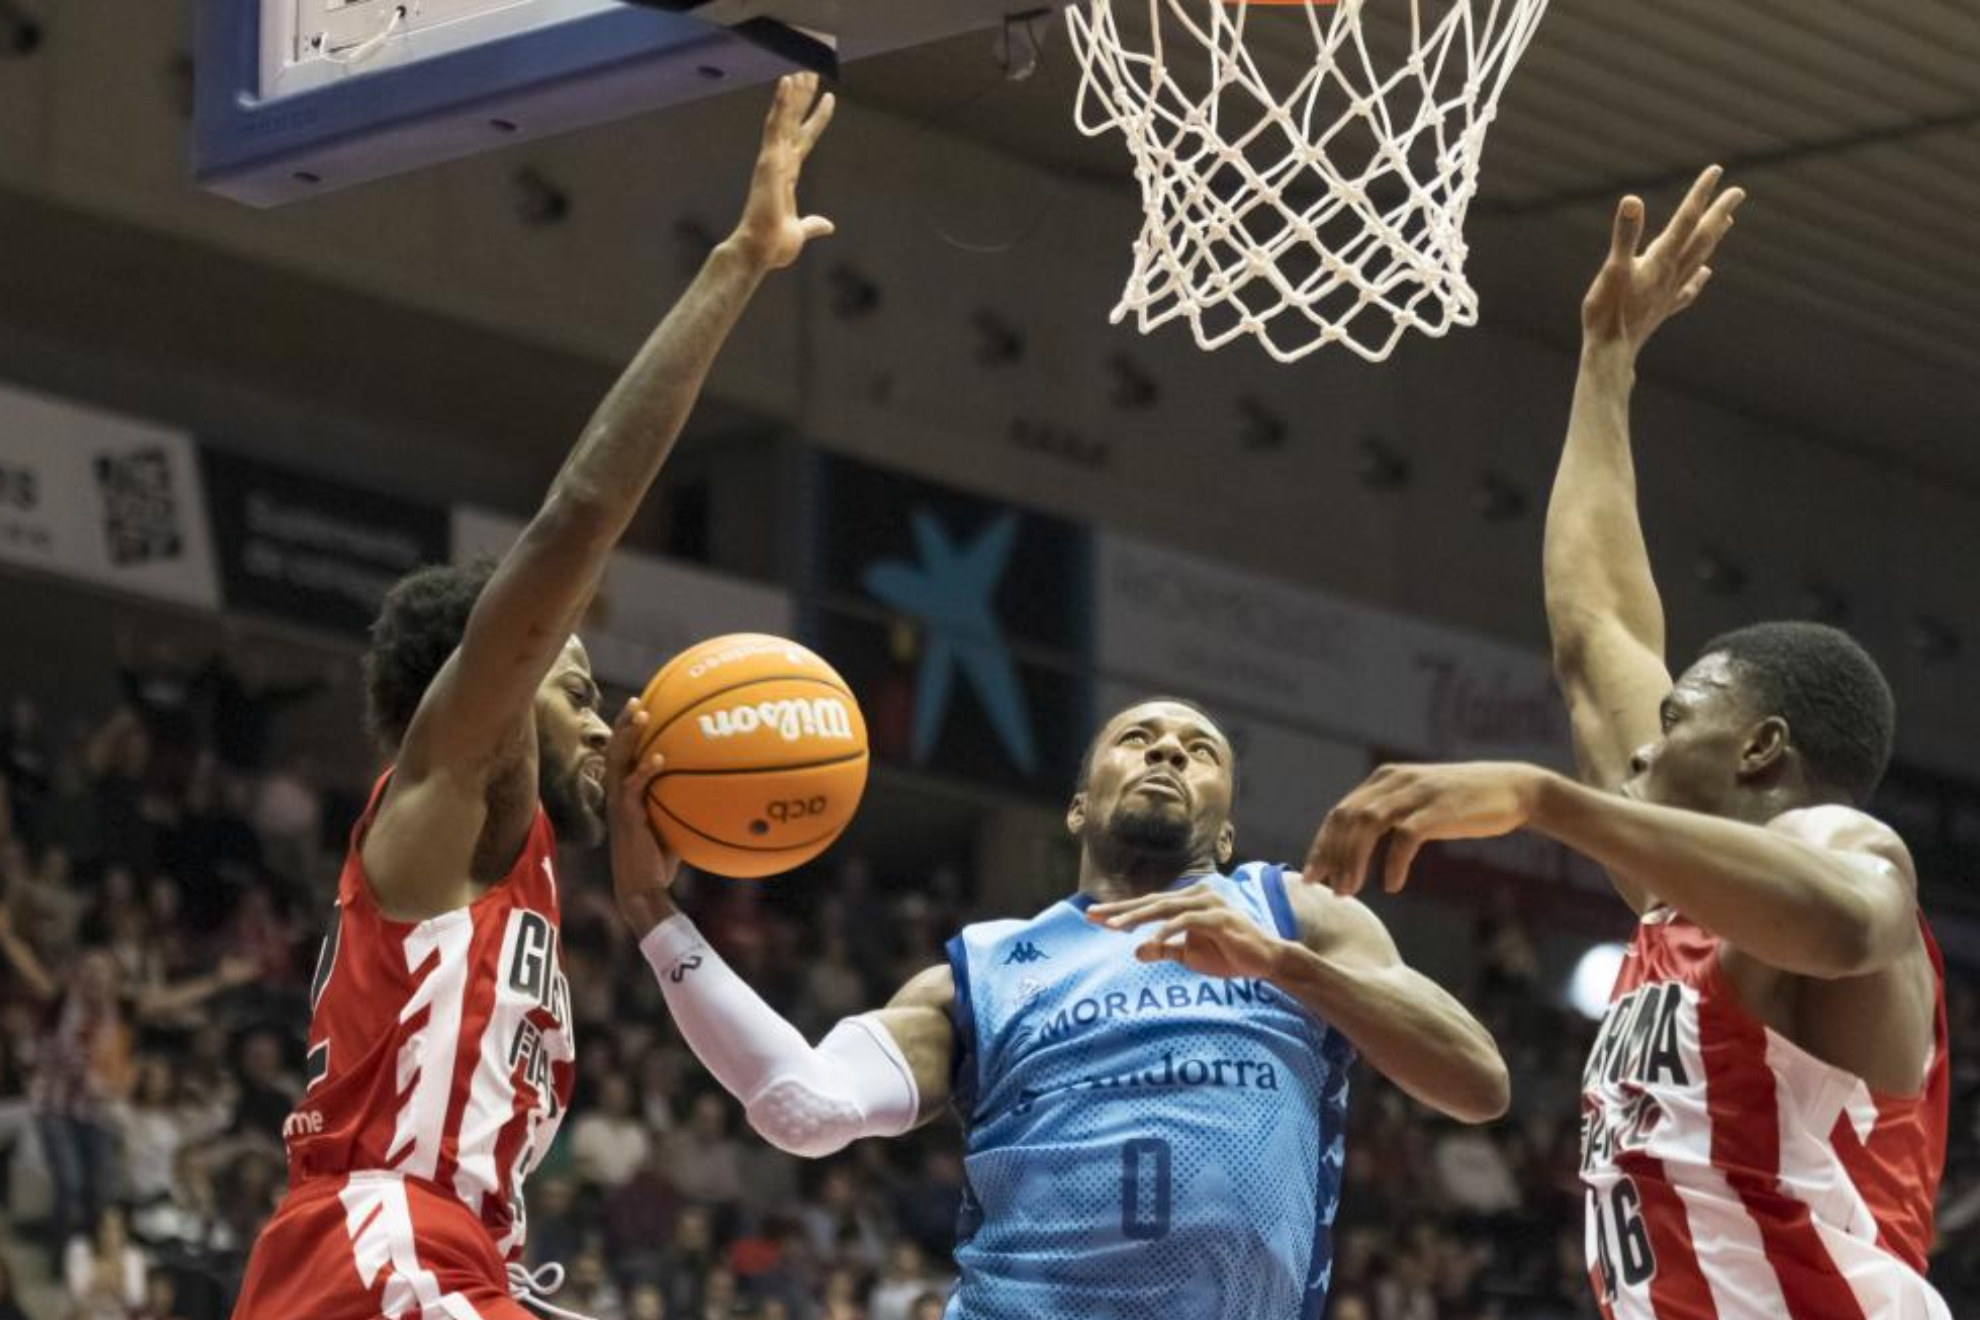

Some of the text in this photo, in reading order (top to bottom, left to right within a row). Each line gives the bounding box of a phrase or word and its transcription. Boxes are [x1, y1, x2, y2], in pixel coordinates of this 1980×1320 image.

[698, 699, 852, 742] Wilson
[767, 795, 827, 823] acb
[1122, 1137, 1172, 1241] 0
